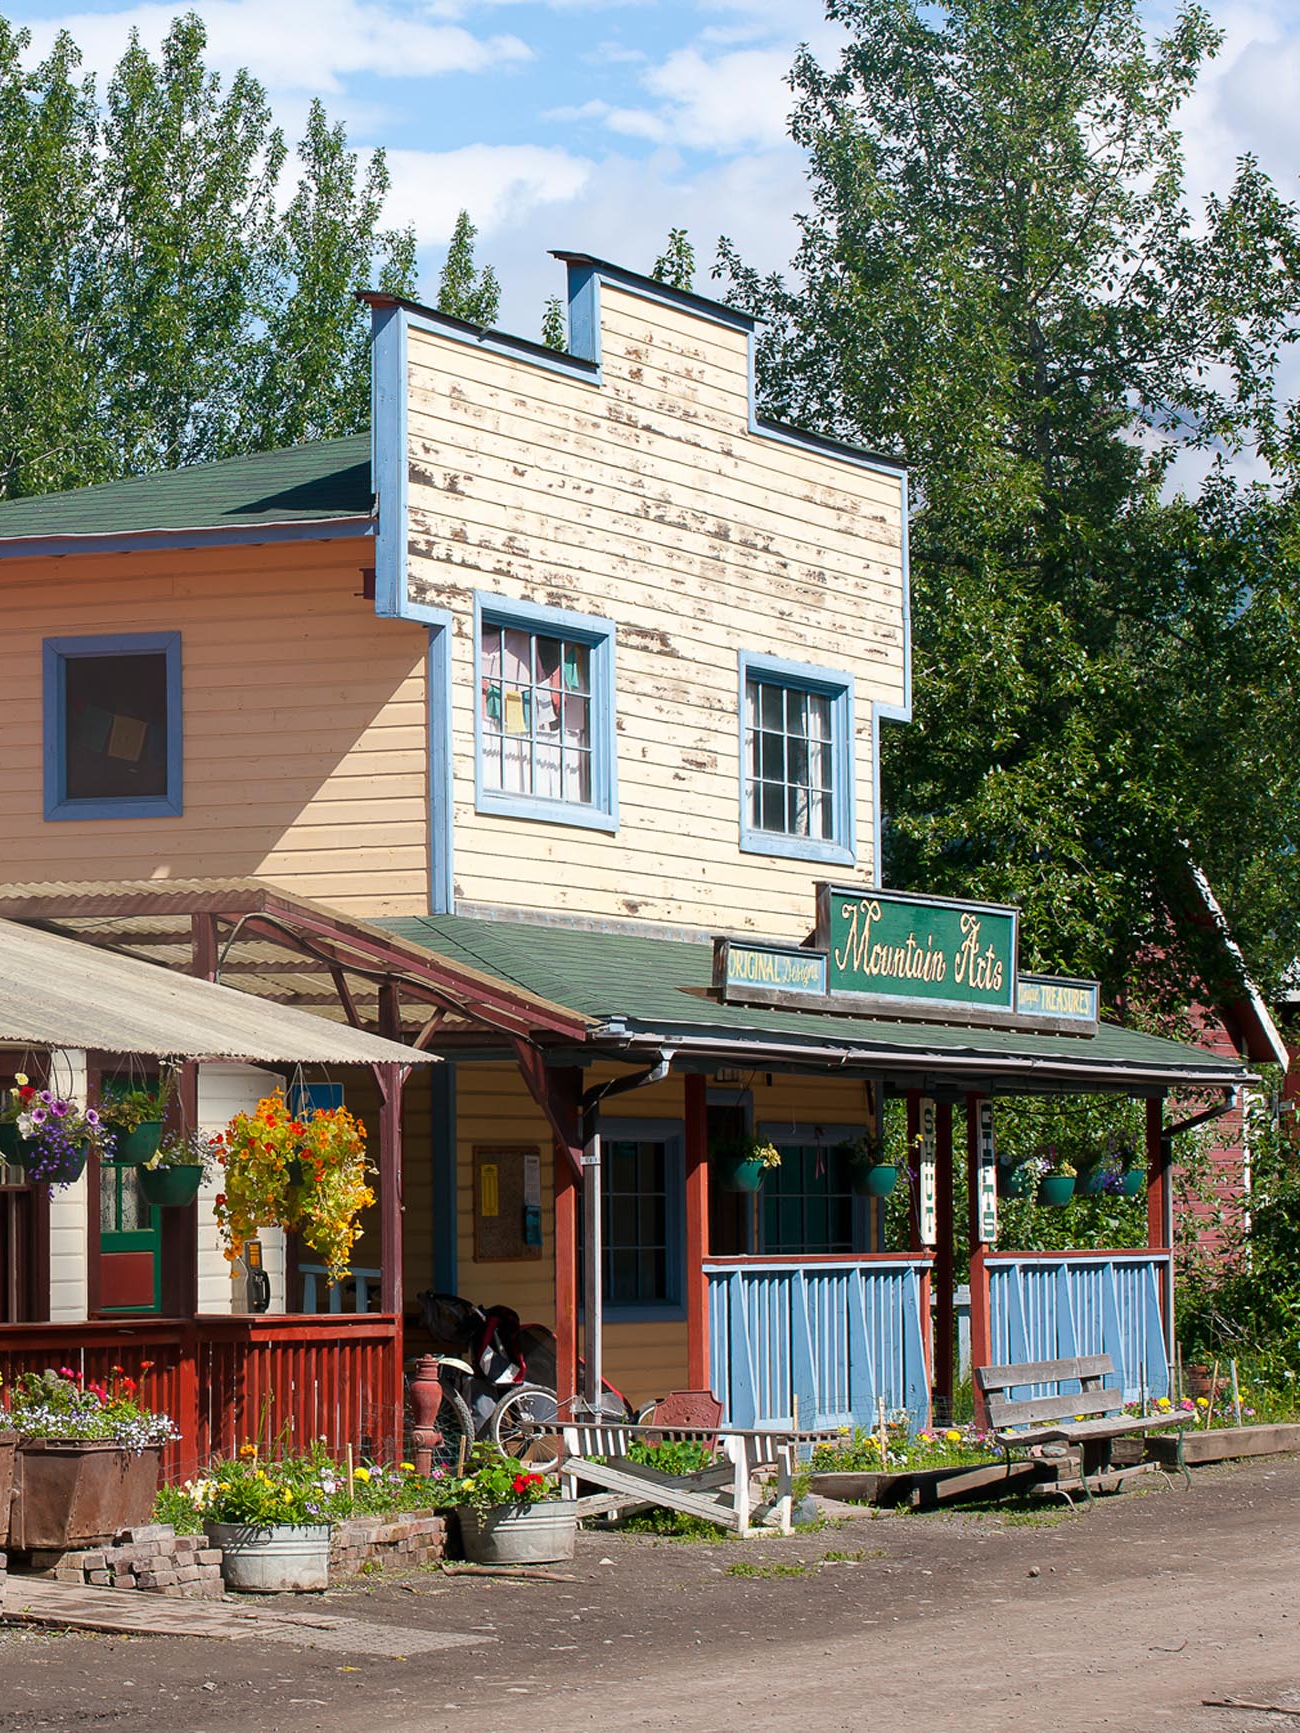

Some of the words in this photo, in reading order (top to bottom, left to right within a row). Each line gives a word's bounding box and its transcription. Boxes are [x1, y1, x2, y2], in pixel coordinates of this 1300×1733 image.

[728, 948, 780, 983] ORIGINAL
[835, 900, 946, 983] Mountain
[955, 912, 1003, 992] Arts
[1041, 985, 1091, 1016] TREASURES
[980, 1103, 995, 1238] GIFTS
